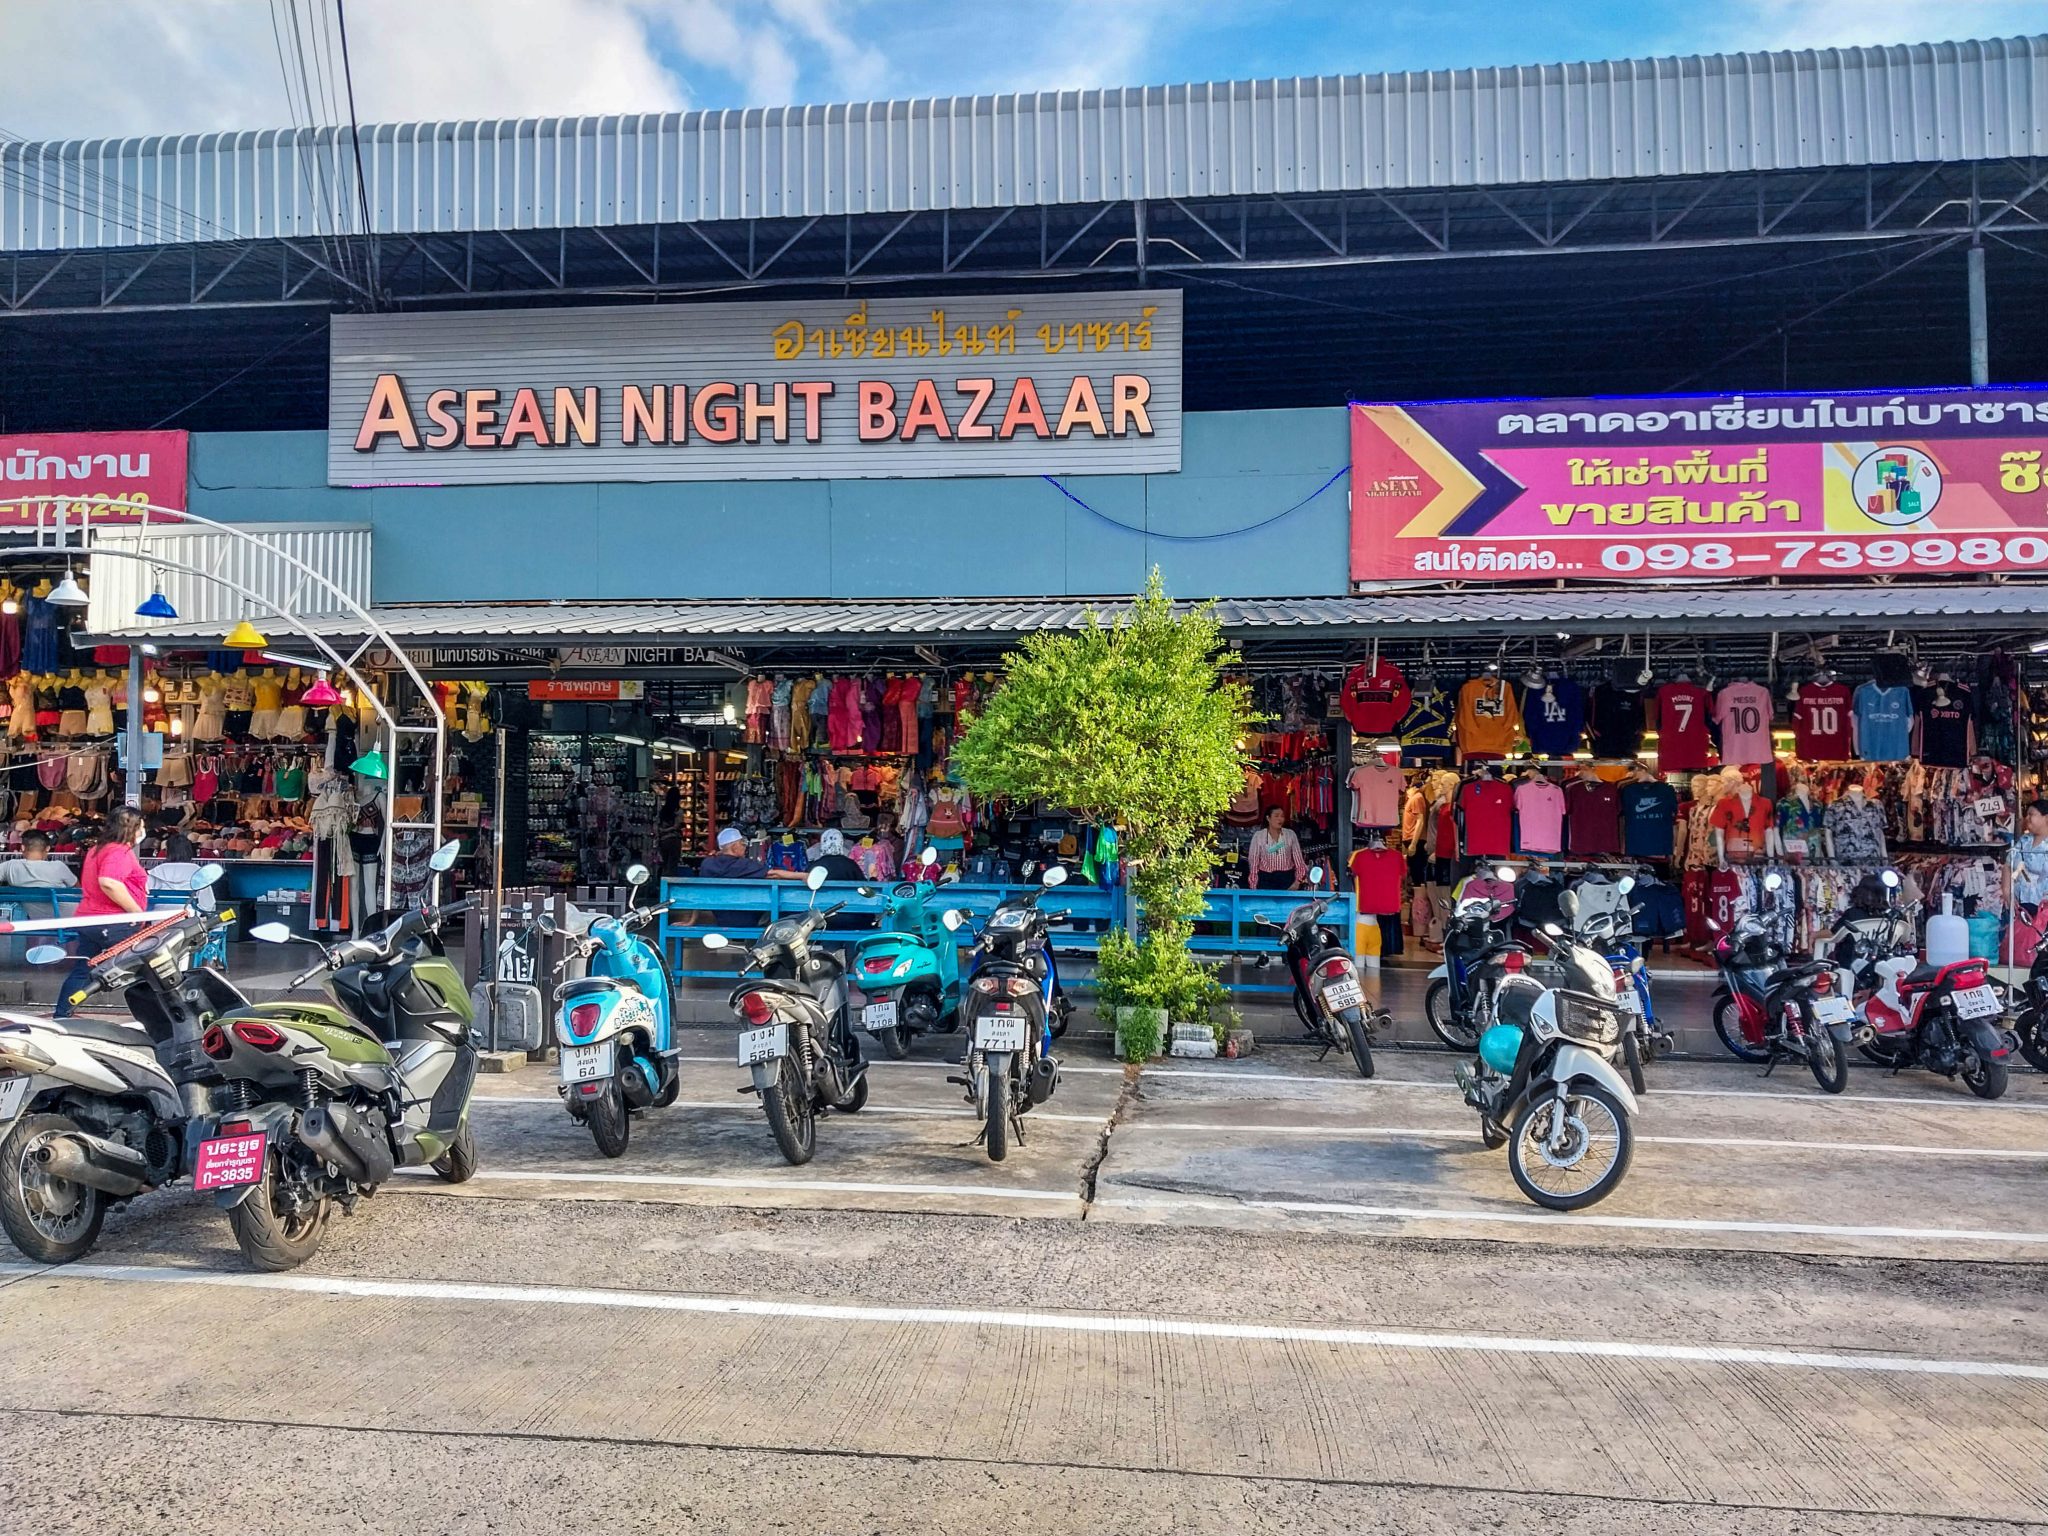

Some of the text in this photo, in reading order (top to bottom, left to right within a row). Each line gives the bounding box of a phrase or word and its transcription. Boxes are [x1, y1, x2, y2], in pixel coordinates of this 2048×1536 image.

[1036, 306, 1157, 354] บาซาร์
[355, 374, 1156, 454] ASEAN NIGHT BAZAAR
[0, 448, 150, 481] นักงาน
[1567, 448, 1768, 487] ให้เช่าพื้นที่
[1372, 480, 1418, 491] ASEAN
[1541, 491, 1801, 526] ขายสินค้า
[1601, 538, 2048, 573] 098-739980
[627, 648, 678, 662] NIGHT
[1544, 702, 1566, 721] LA
[1733, 696, 1757, 704] MESSI
[1674, 704, 1693, 732] 7
[1730, 707, 1760, 734] 10
[1811, 707, 1838, 735] 10
[1718, 895, 1728, 922] 8
[750, 1048, 775, 1062] 526
[983, 1039, 1016, 1049] 7711
[580, 1066, 596, 1078] 64
[203, 1167, 253, 1185] ก-3835
